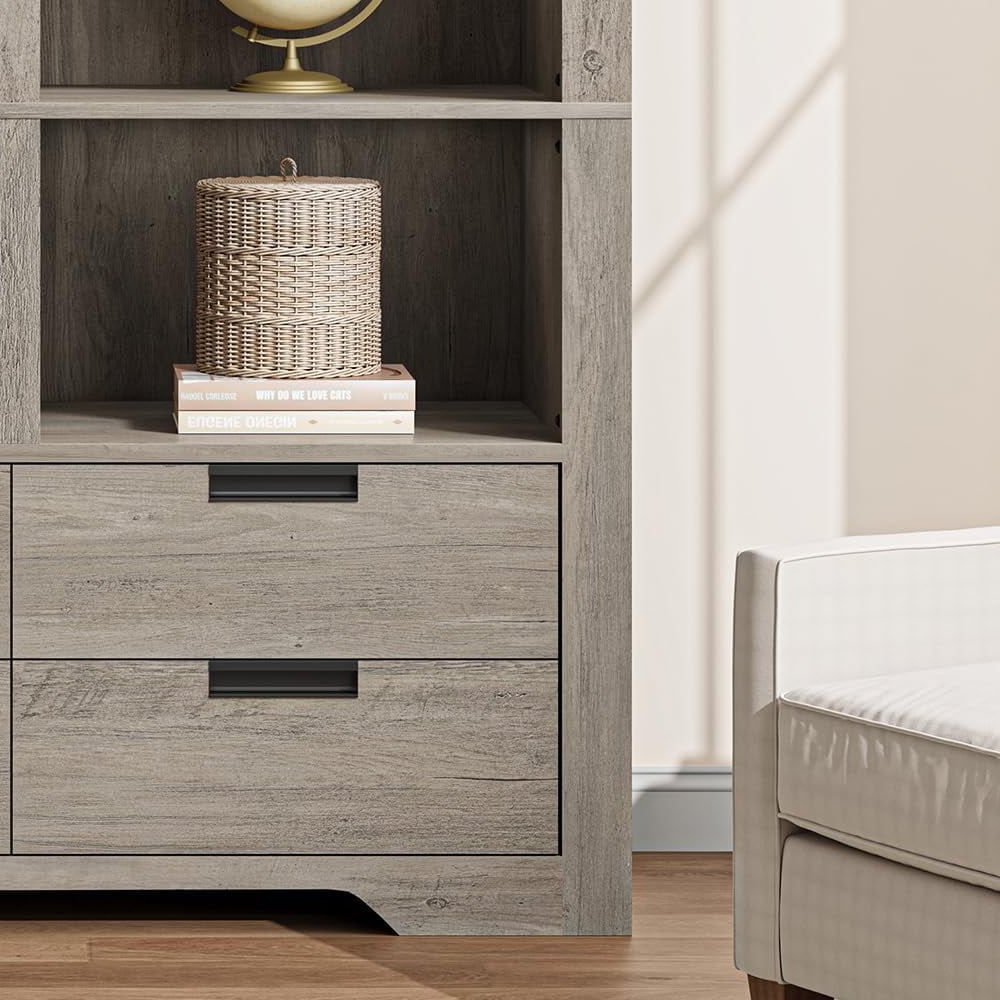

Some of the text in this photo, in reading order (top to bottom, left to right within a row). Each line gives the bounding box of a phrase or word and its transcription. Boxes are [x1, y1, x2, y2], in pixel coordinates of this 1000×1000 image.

[255, 390, 352, 401] WHY DO WE LOVE CATS
